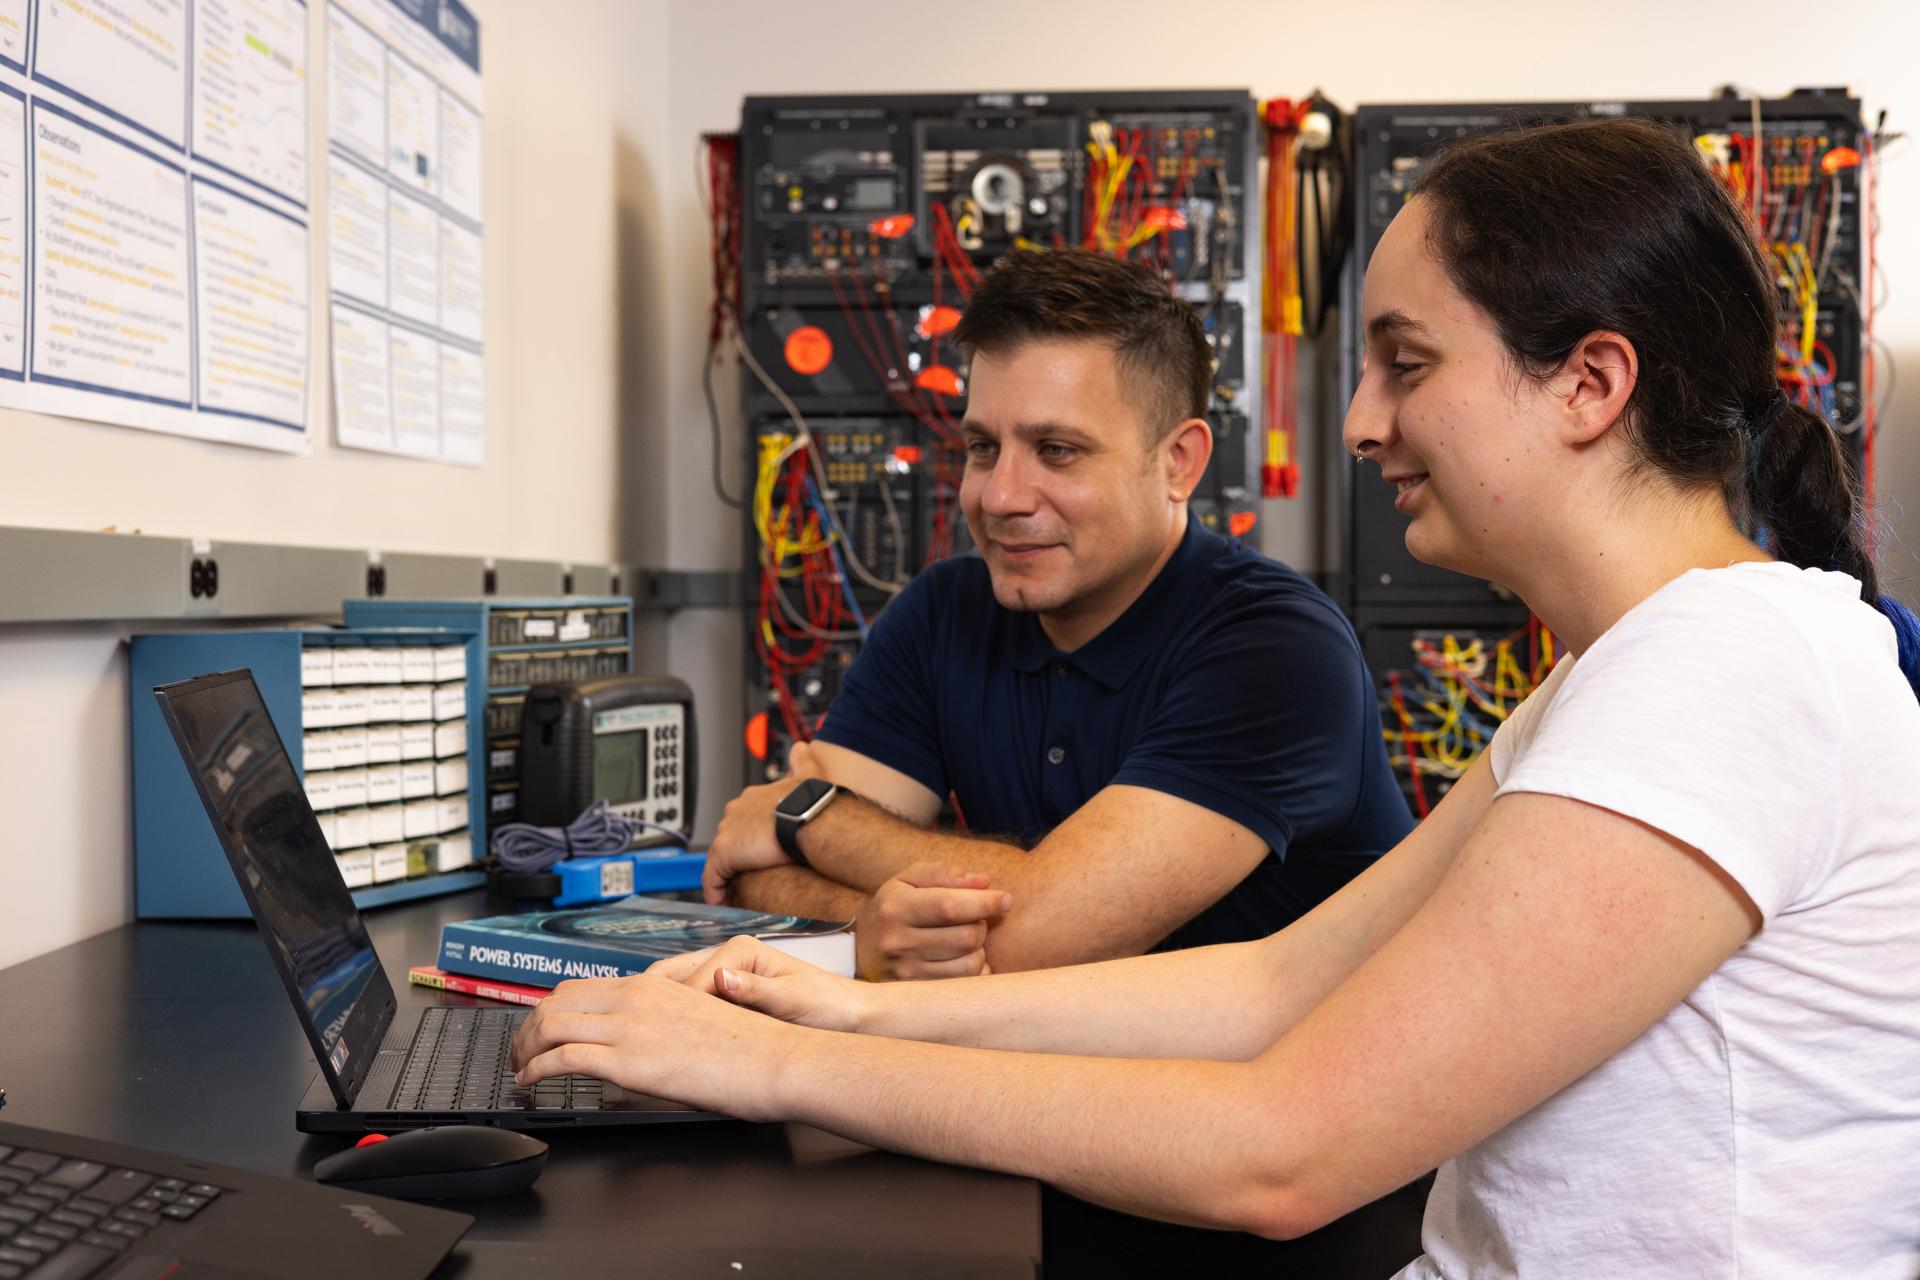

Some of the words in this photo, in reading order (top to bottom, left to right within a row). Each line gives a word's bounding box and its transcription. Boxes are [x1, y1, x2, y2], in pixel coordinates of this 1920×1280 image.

[469, 945, 511, 967] POWER
[512, 951, 563, 975] SYSTEMS
[563, 960, 620, 979] ANALYSIS
